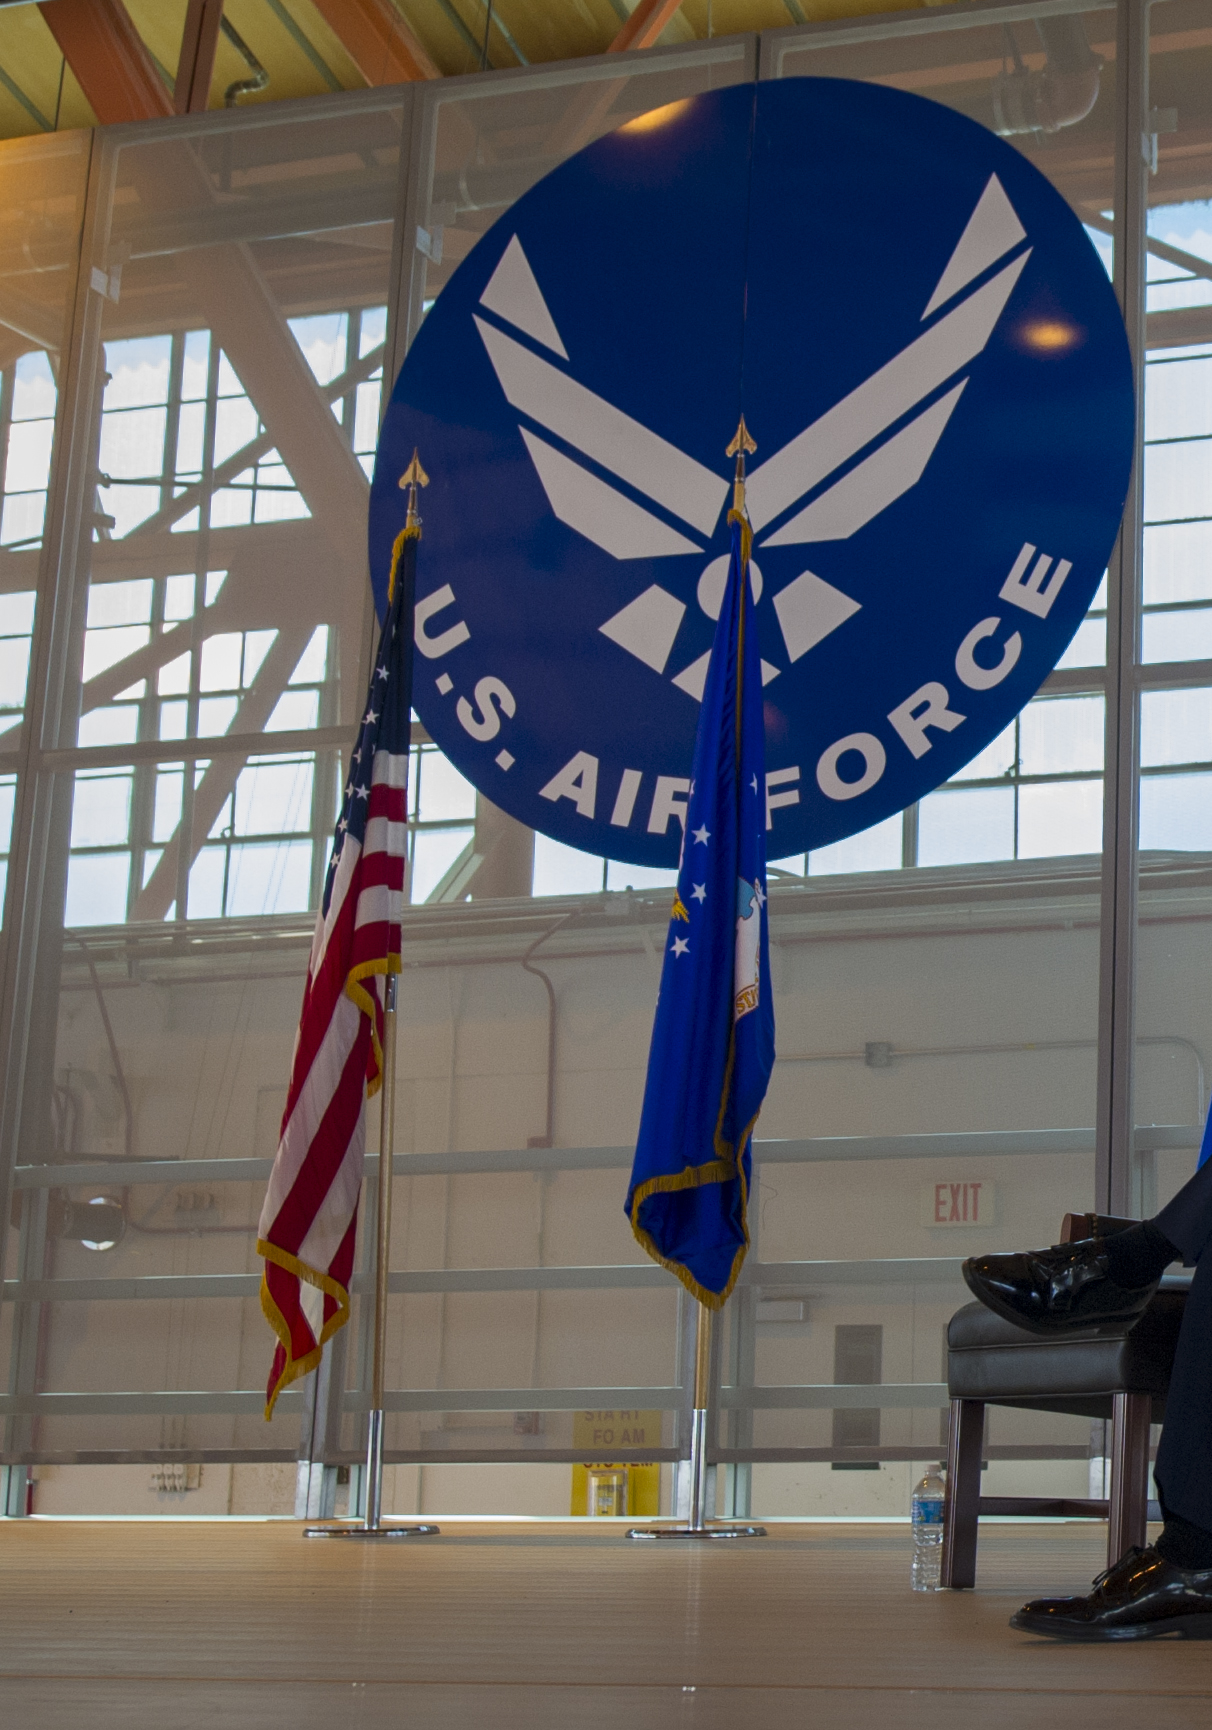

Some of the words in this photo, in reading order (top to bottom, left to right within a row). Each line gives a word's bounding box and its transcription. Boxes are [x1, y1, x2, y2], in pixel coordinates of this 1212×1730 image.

[414, 583, 516, 771] U.S.
[765, 542, 1073, 831] FORCE
[934, 1183, 982, 1222] EXIT
